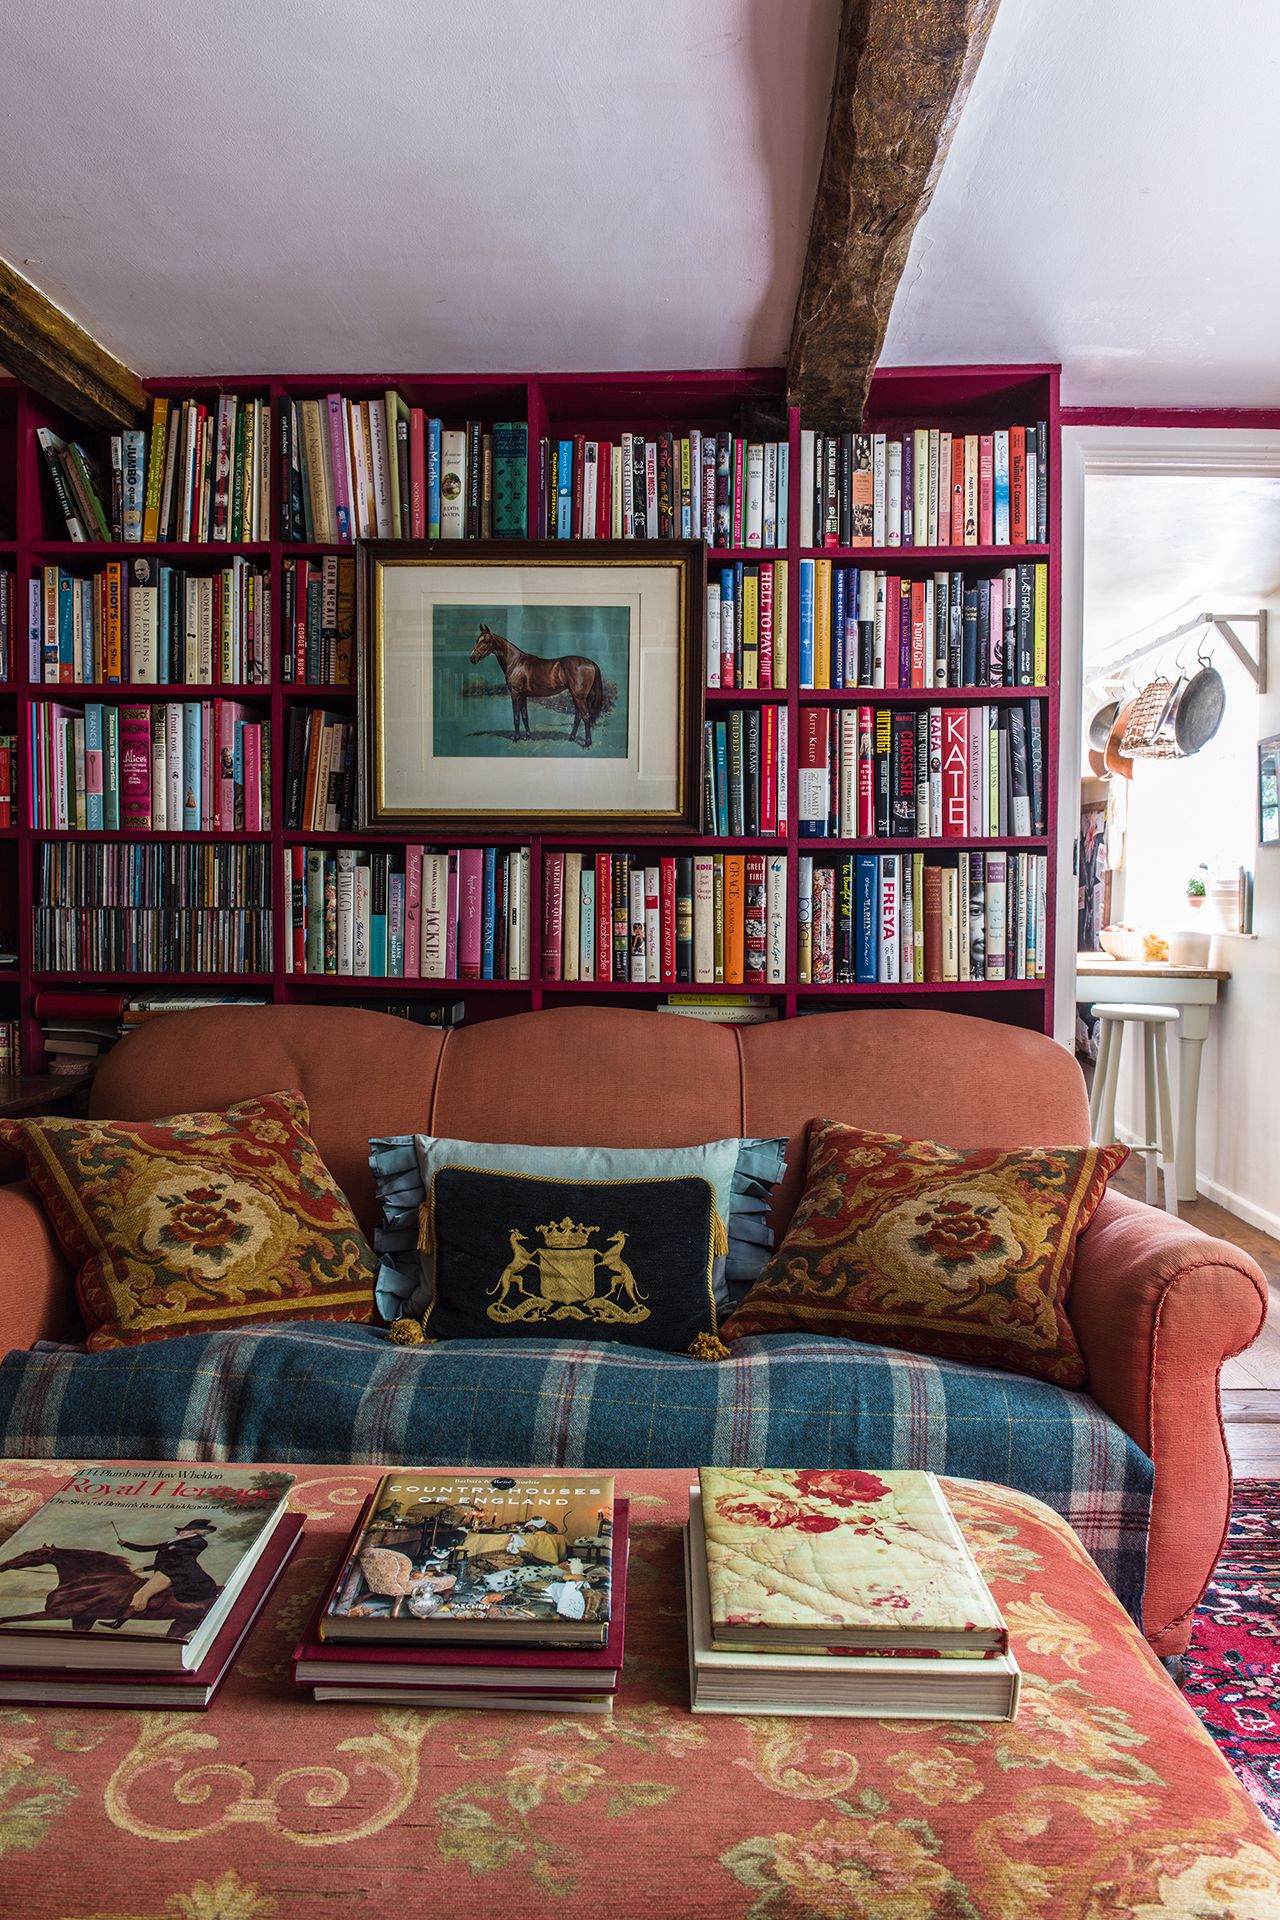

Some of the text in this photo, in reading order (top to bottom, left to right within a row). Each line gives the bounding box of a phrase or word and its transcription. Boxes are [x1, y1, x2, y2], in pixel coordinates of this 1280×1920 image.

[127, 445, 137, 485] JUMBO
[309, 438, 318, 471] Norman
[828, 441, 836, 457] BLACK
[429, 451, 438, 486] Martha
[647, 460, 655, 475] KATE
[707, 468, 715, 499] DEBORAH
[1013, 456, 1021, 482] Vitamin
[54, 478, 71, 516] KENNEDY CURSE
[660, 494, 669, 513] Life
[828, 476, 836, 498] AVENGER
[327, 559, 336, 584] JOHN
[1021, 577, 1030, 597] LAST
[110, 582, 118, 620] IDIOT'S
[761, 571, 772, 656] HELL TO PAY
[109, 626, 117, 646] Feng
[140, 617, 150, 663] JENKINS
[875, 609, 883, 641] LONDON
[913, 622, 923, 669] Funny Girl
[171, 713, 179, 734] front
[809, 713, 817, 763] KITTY KELLEY
[876, 711, 891, 754] OUTRAGE
[931, 715, 940, 752] RAFA
[749, 729, 757, 774] OTHER MAN
[900, 731, 913, 797] CROSSFIRE
[918, 714, 927, 805] NADINE GORDIMER JUMP
[1031, 726, 1042, 773] FACTORY
[943, 716, 967, 824] KATE
[90, 795, 98, 822] QUINN
[812, 785, 821, 817] FAMILY
[408, 855, 419, 879] Perfect
[728, 862, 740, 899] GRACE
[339, 875, 352, 912] TWIGGY
[552, 907, 560, 936] QUEEN
[863, 899, 871, 935] MARILYN
[883, 882, 895, 941] FREYA
[355, 919, 364, 940] Julia
[425, 909, 440, 958] JACKIE
[485, 917, 493, 954] FRANCE
[600, 917, 609, 970] elizabeth adler
[61, 1477, 281, 1505] Royal Heritage
[99, 1469, 223, 1480] Plumb and Huw Wheldon
[389, 1486, 501, 1494] COUNTRY
[458, 1497, 569, 1505] ENGLAND
